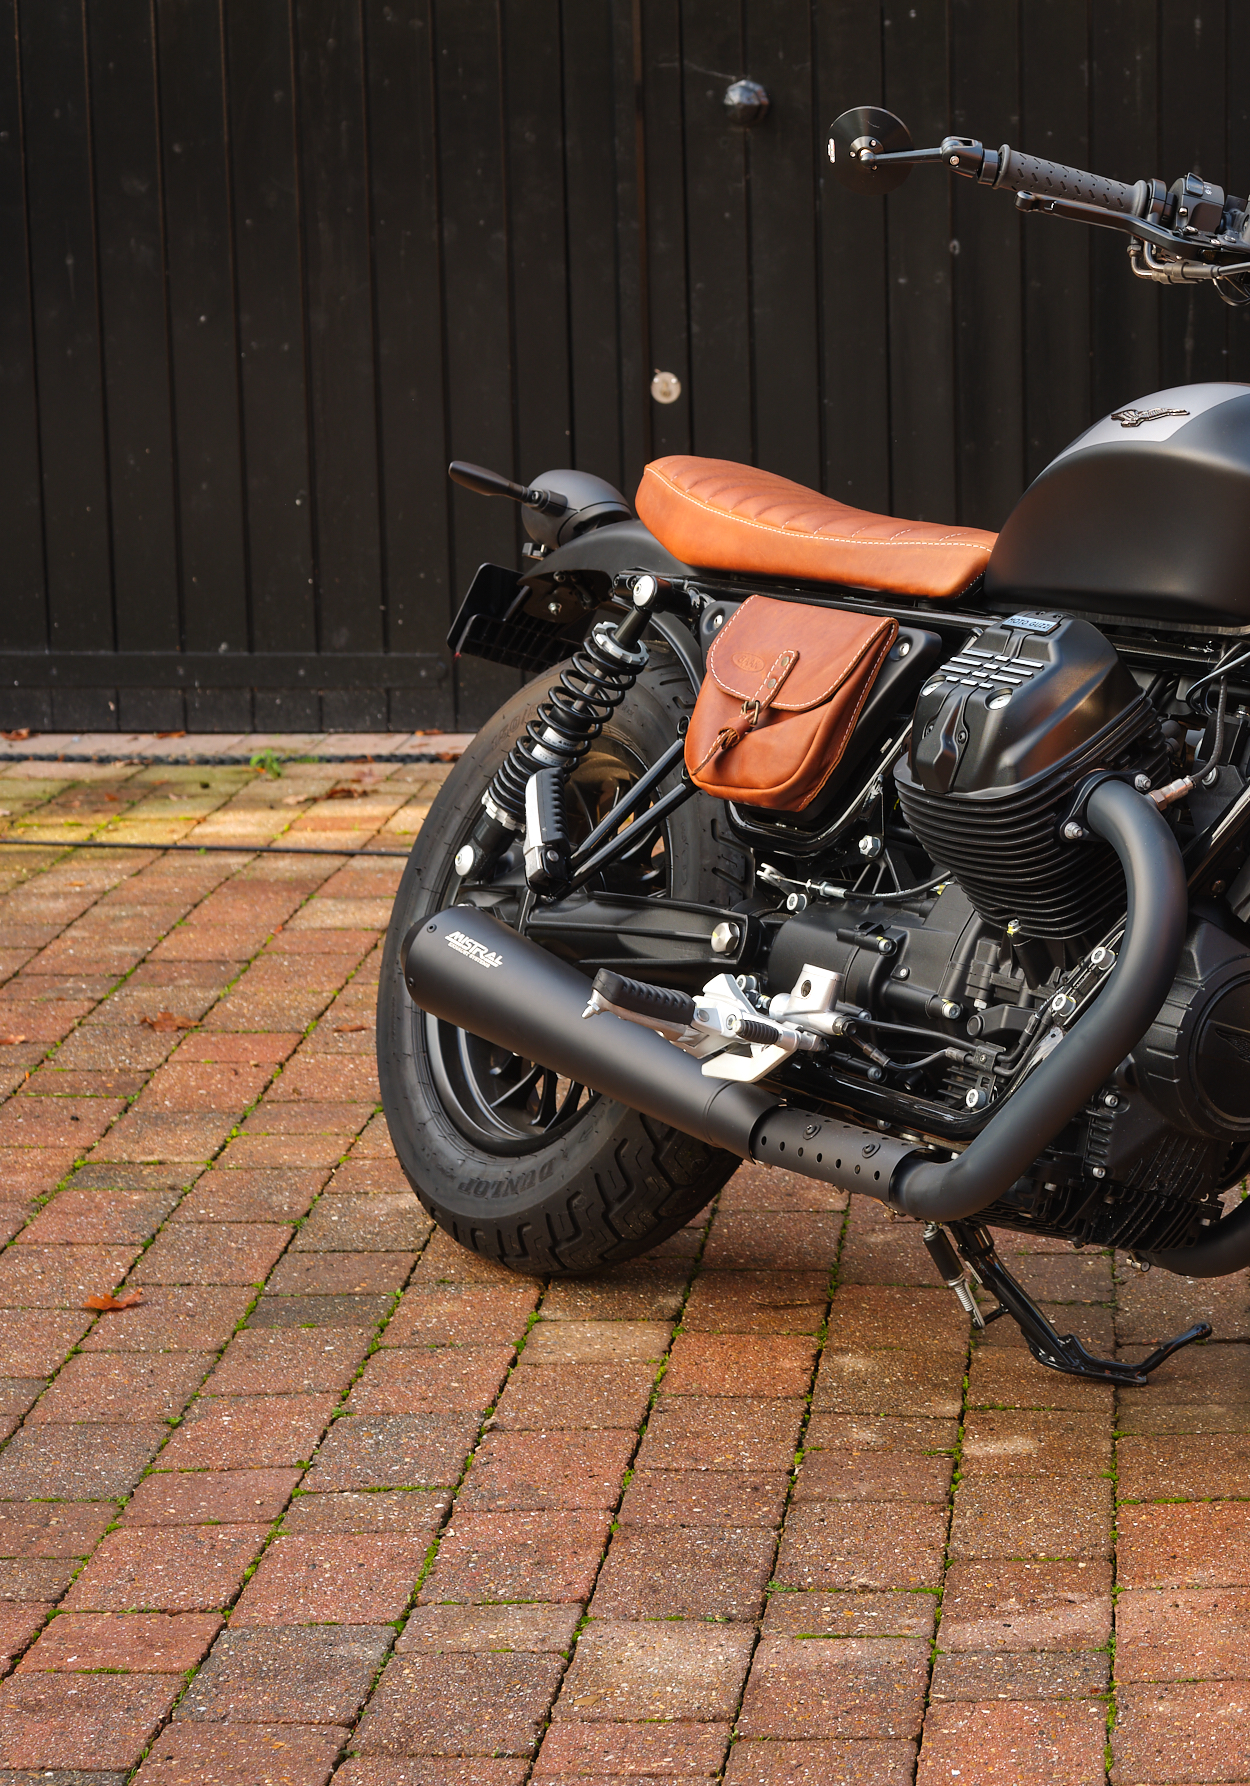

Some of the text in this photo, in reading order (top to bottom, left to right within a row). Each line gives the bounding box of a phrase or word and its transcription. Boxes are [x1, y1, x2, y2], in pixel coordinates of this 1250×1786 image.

[1008, 617, 1053, 630] MOTO GUZZI
[444, 930, 504, 967] MISTRAL
[457, 1157, 556, 1199] DUNLOP
